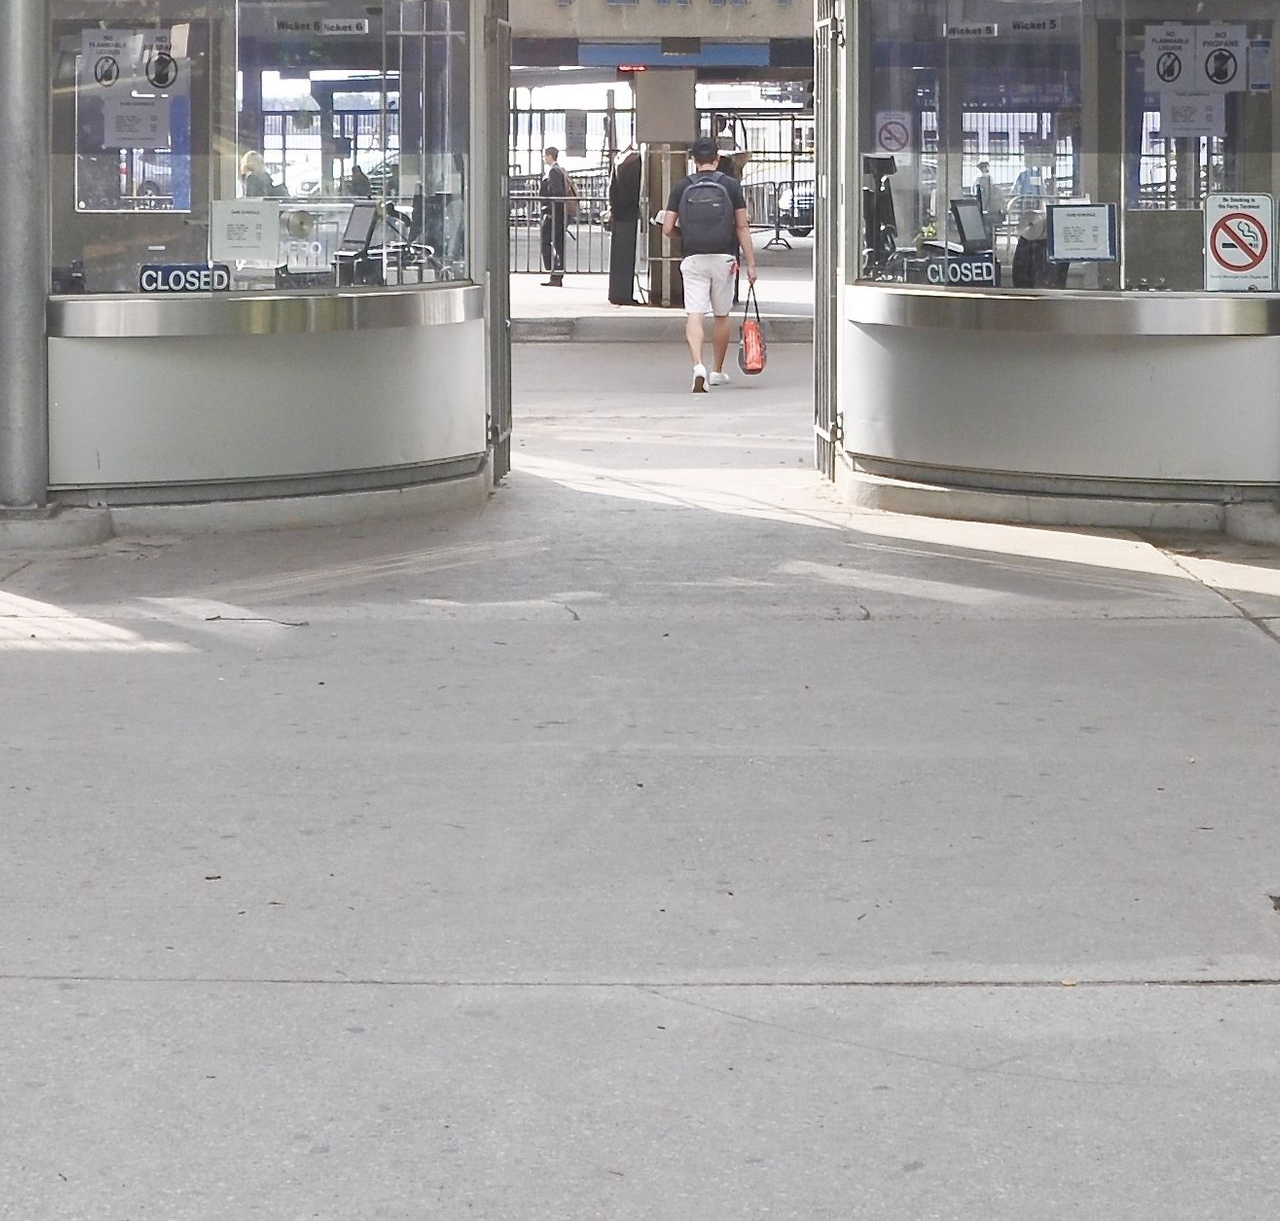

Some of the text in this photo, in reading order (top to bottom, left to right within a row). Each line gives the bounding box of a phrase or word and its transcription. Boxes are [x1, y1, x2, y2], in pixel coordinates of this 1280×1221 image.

[277, 21, 320, 32] Wicket 6
[355, 22, 363, 32] 6
[948, 25, 993, 35] Wicket 5
[1011, 19, 1057, 30] Wicket 5
[1202, 40, 1239, 48] PROPANE
[926, 261, 994, 284] CLOSED
[141, 270, 228, 291] CLOSED
